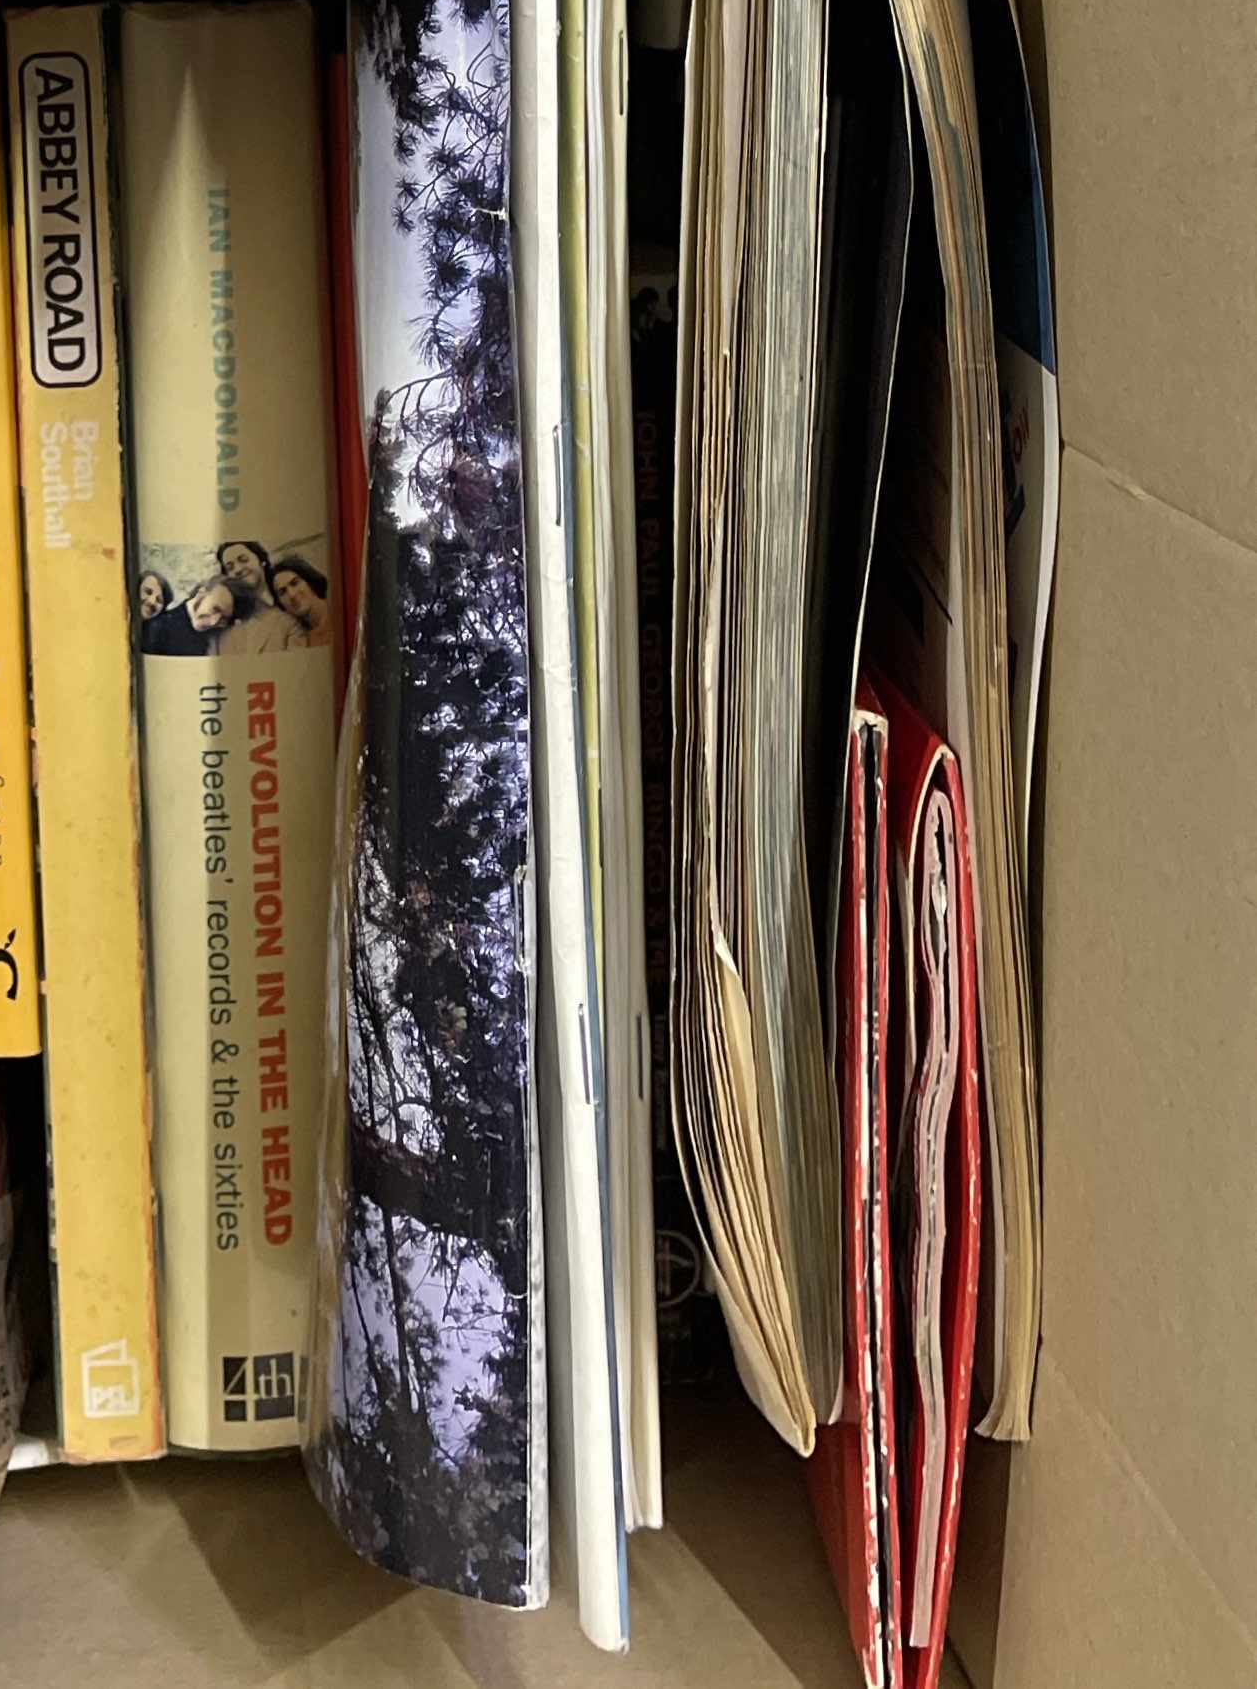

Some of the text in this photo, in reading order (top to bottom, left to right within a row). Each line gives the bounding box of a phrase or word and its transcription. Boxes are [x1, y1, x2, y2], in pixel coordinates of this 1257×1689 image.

[35, 67, 85, 372] ABBEY ROAD
[207, 189, 240, 512] IAN MACDONALD
[41, 420, 71, 548] Southall
[71, 420, 98, 500] Brian
[198, 683, 243, 1250] the beatles' records & the sixties
[246, 682, 292, 1246] REVOLUTION IN THE HEAD
